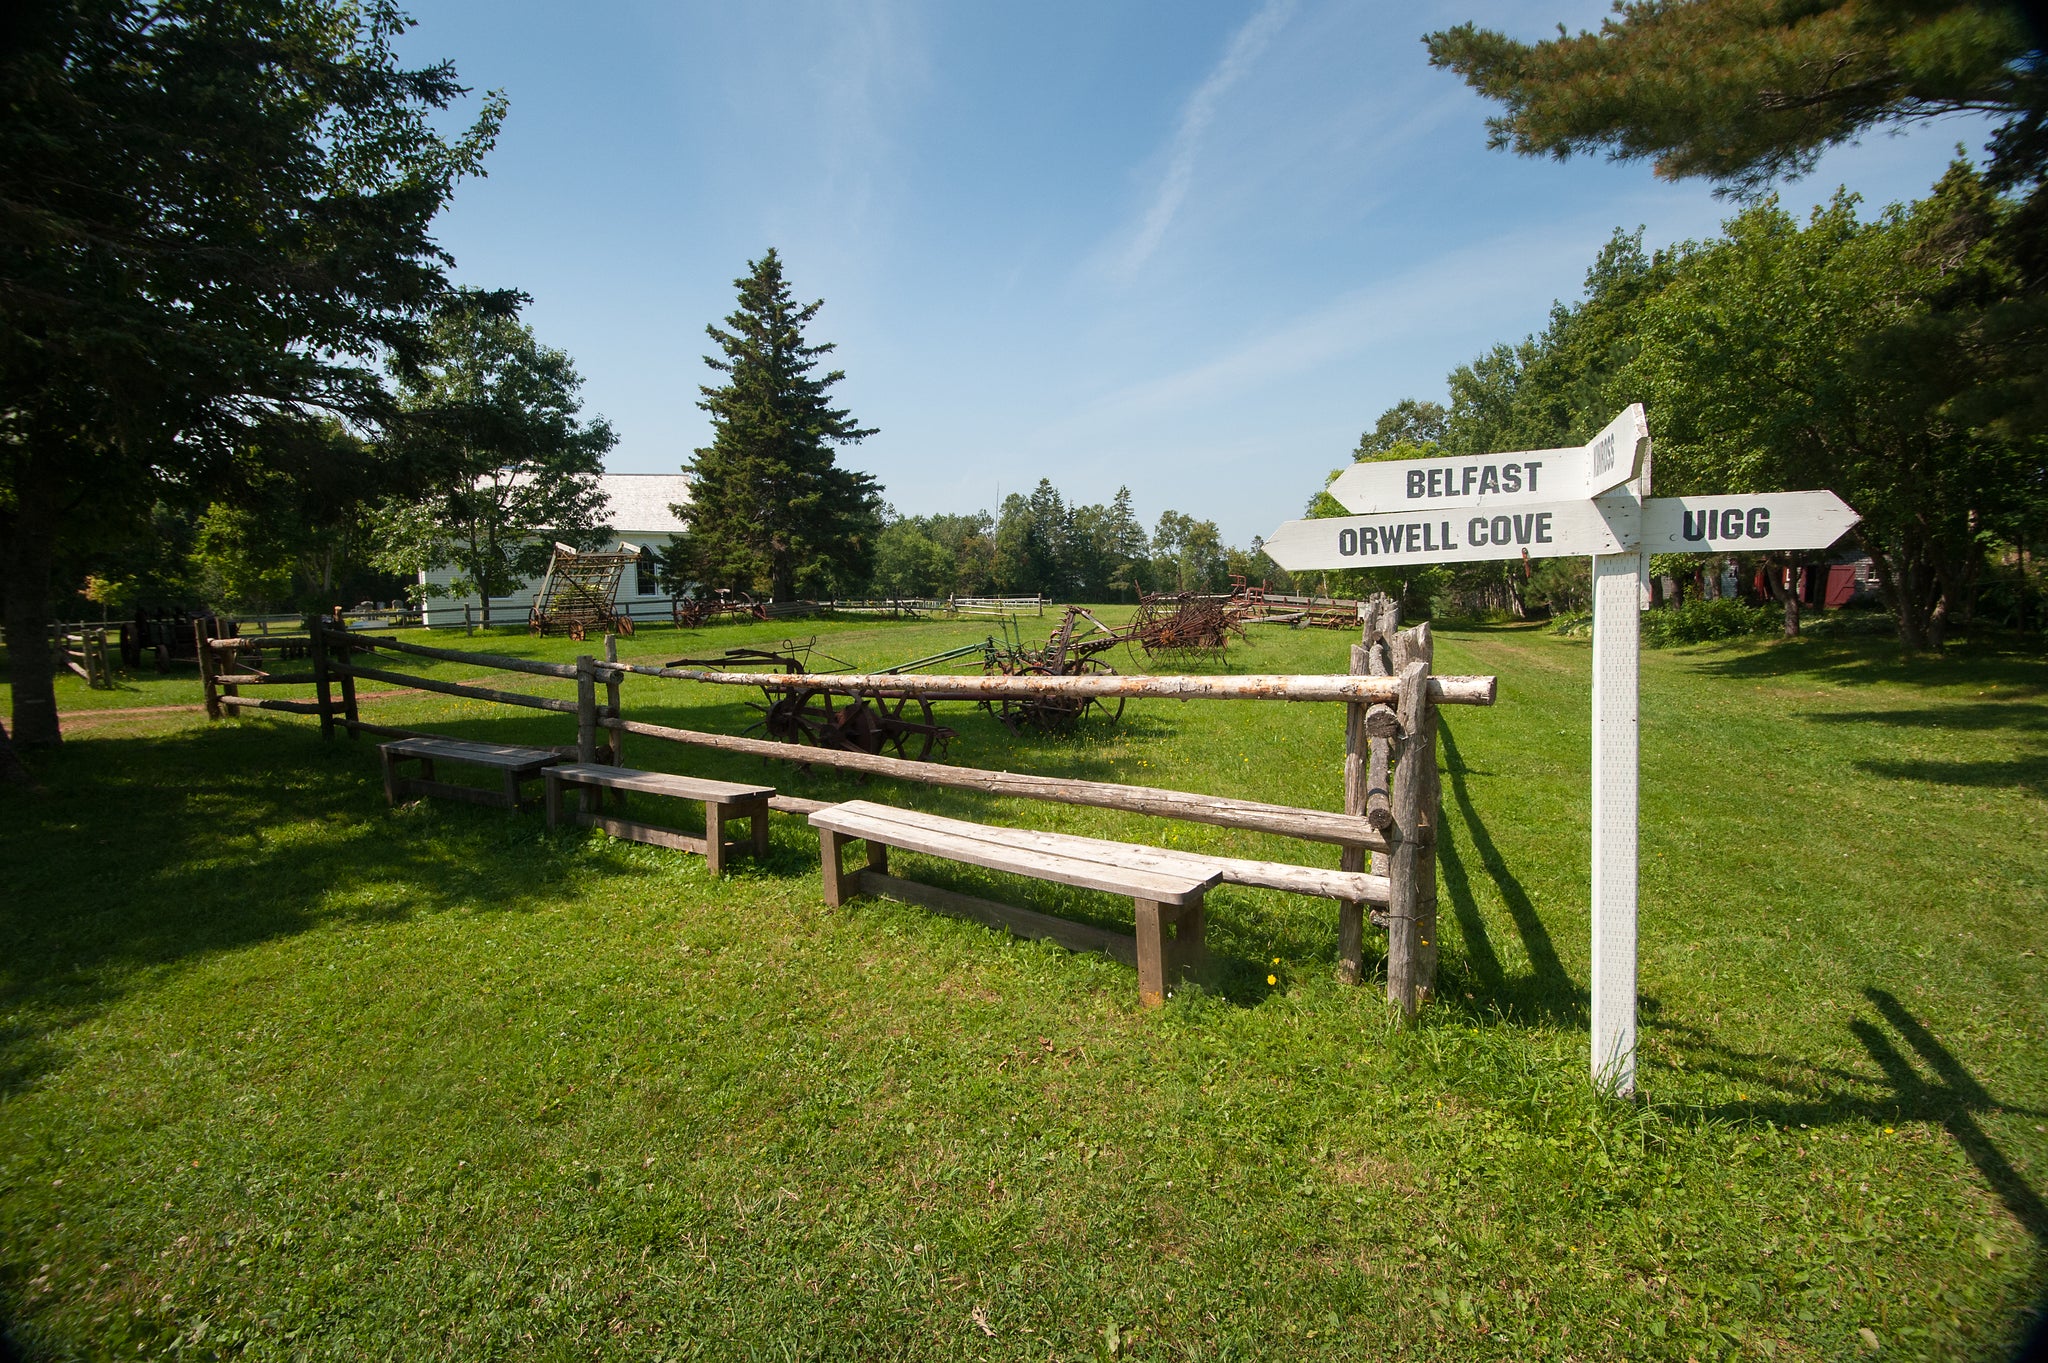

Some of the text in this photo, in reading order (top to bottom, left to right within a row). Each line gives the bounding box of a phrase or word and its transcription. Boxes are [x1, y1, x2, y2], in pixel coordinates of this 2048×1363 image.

[1406, 461, 1543, 499] BELFAST
[1339, 512, 1553, 557] ORWELL COVE
[1682, 507, 1771, 542] UIGG
